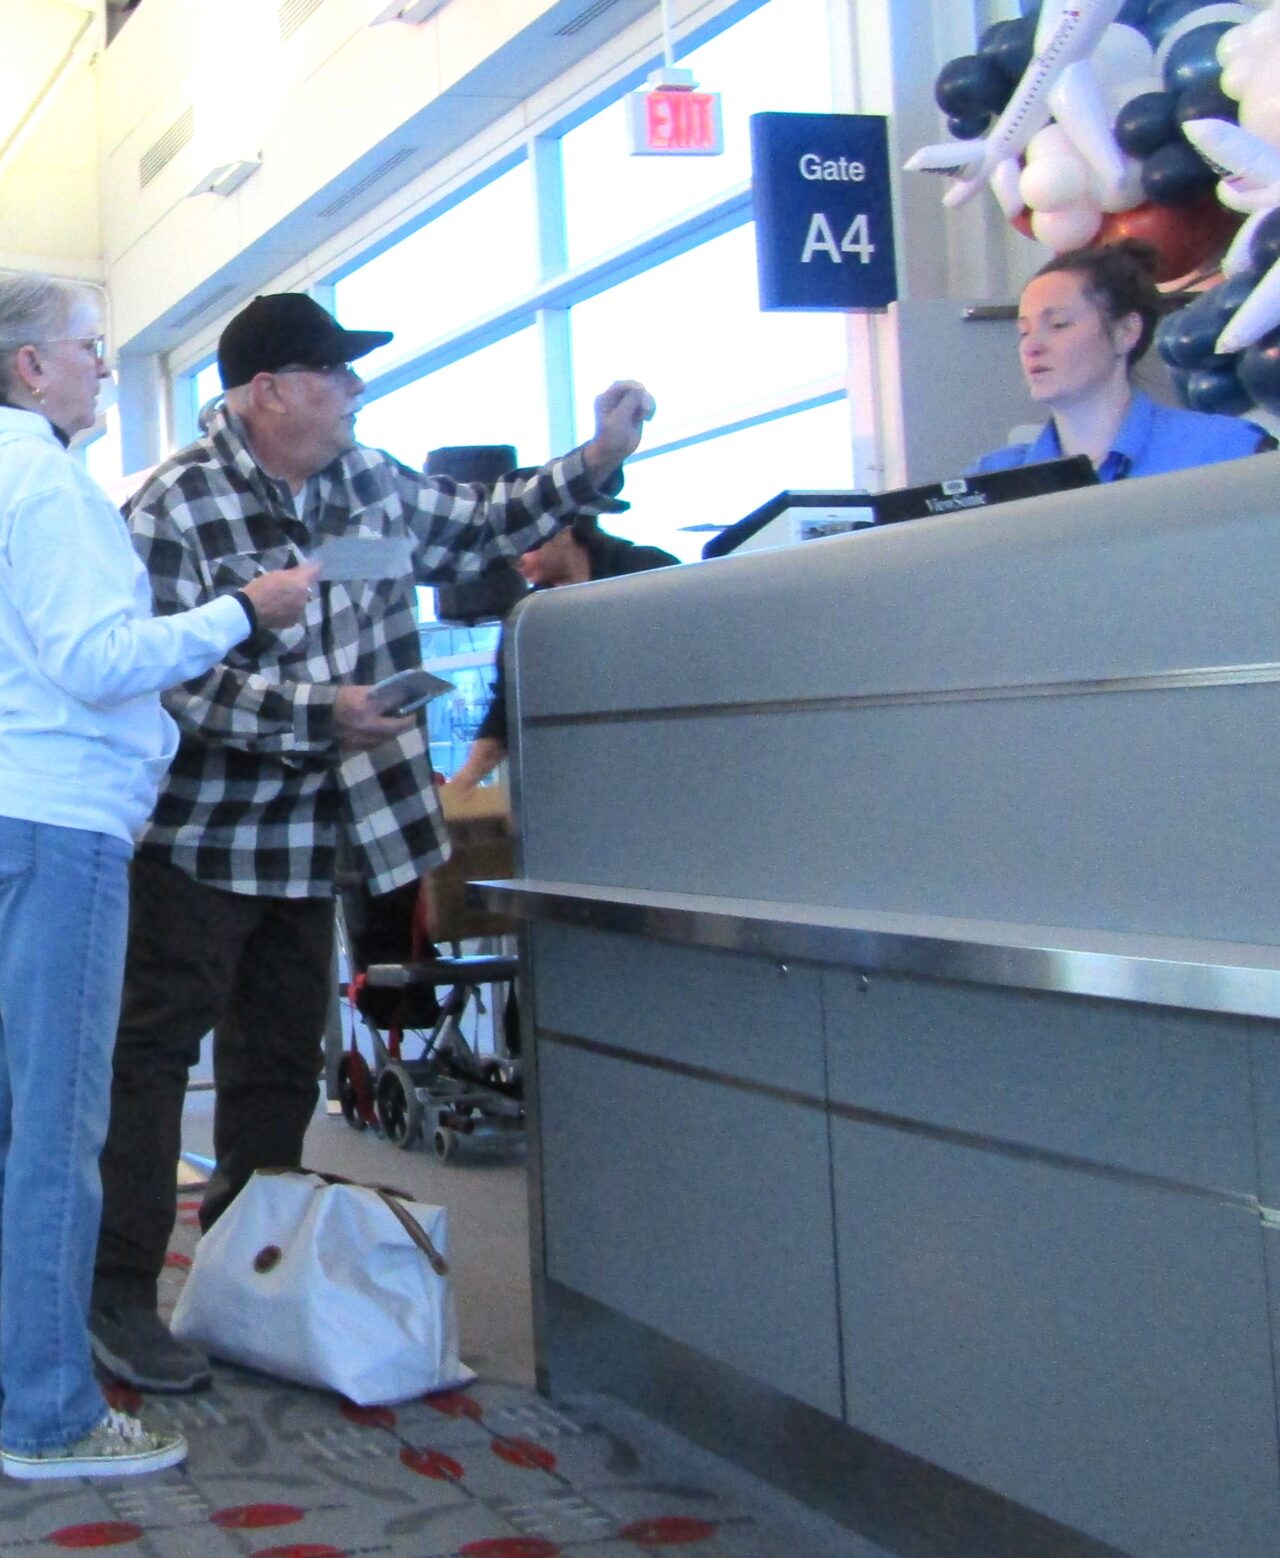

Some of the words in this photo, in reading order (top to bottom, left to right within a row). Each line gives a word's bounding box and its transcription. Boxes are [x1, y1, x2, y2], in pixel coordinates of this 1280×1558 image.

[646, 93, 713, 148] EXIT
[799, 154, 866, 181] Gate
[800, 213, 875, 264] A4
